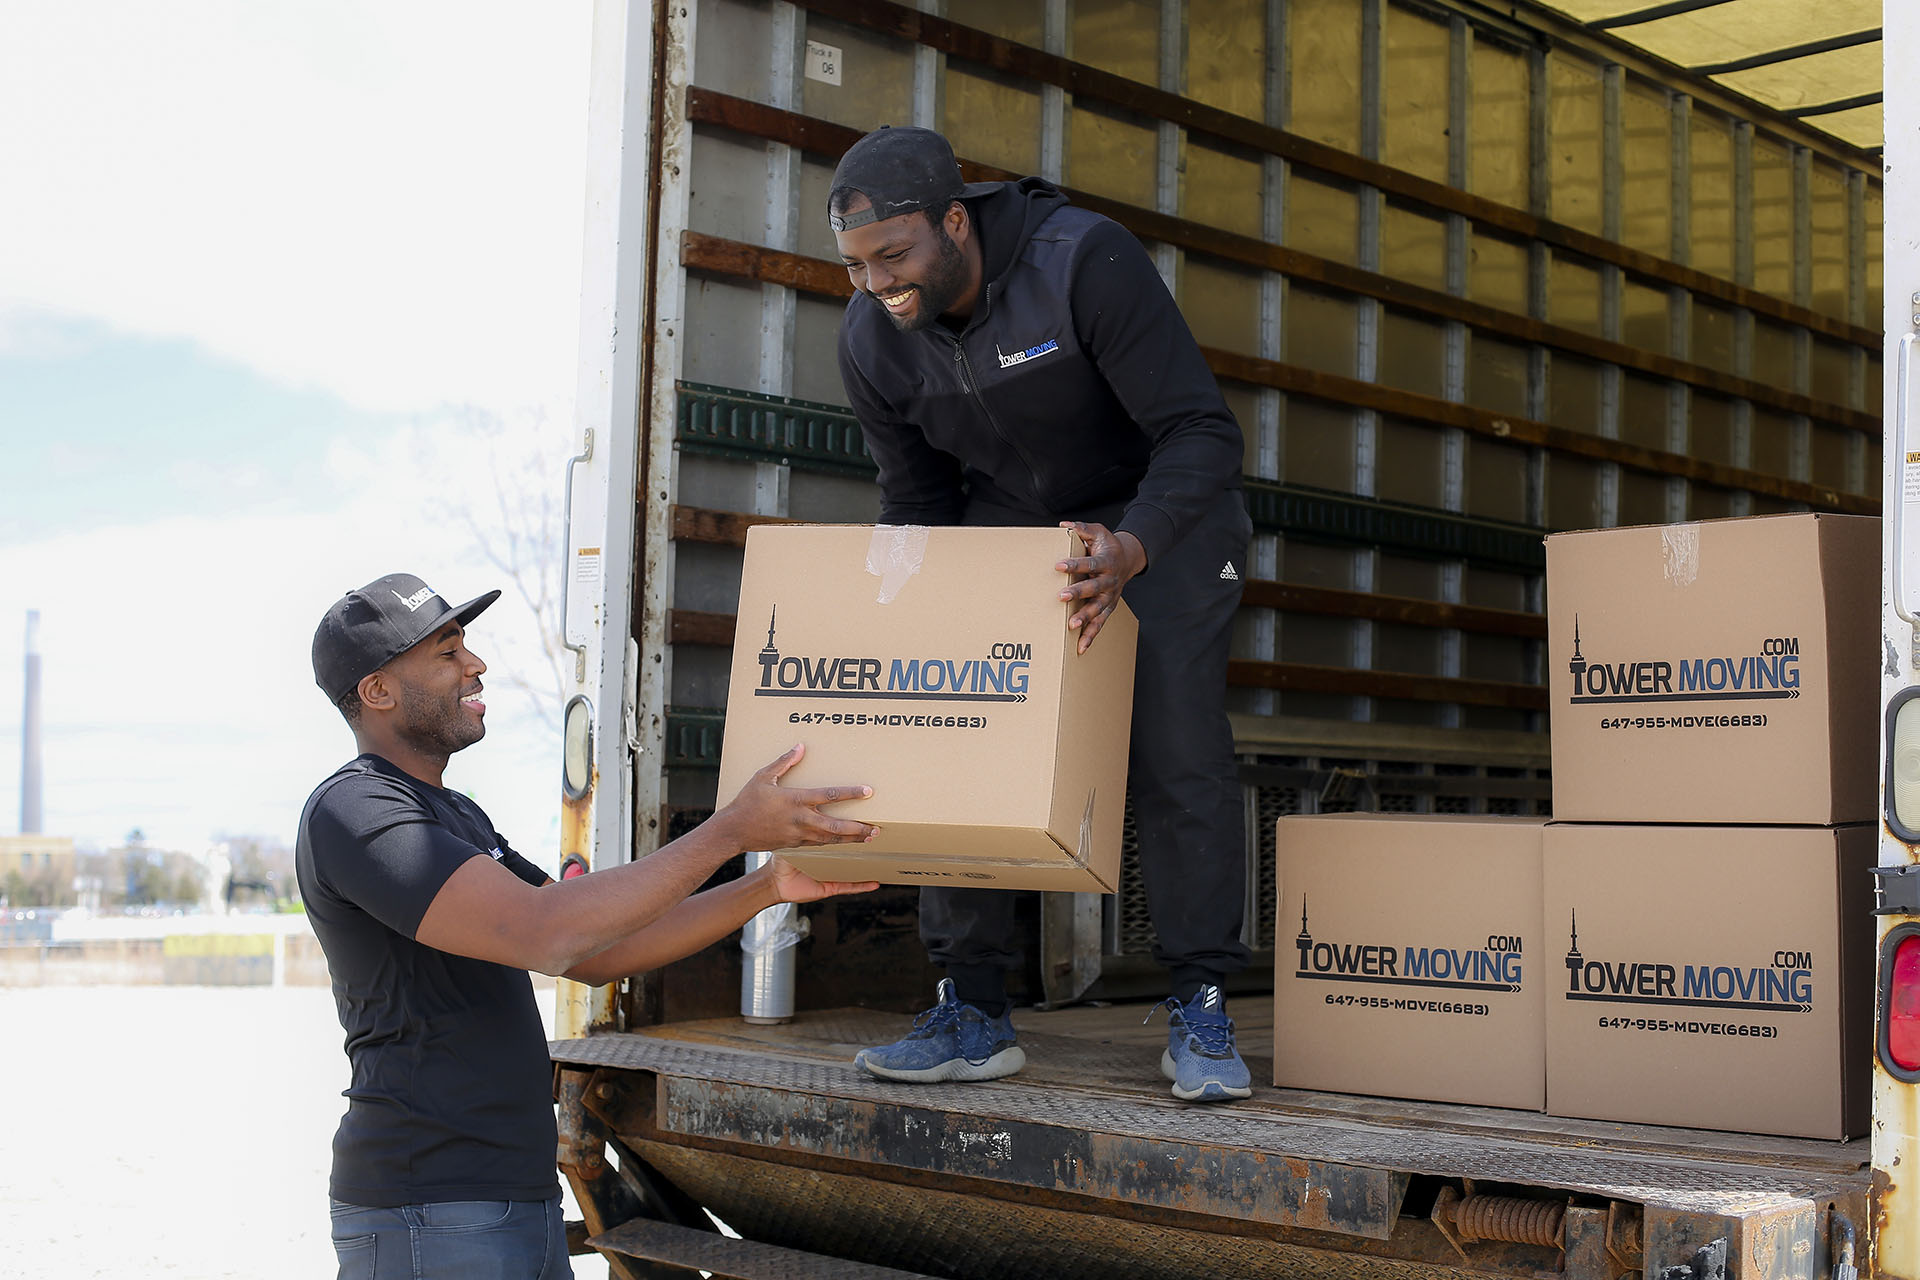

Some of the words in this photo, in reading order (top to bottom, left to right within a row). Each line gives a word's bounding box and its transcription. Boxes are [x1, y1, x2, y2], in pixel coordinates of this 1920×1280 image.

[822, 62, 834, 75] 06
[998, 350, 1026, 366] TOWER
[1025, 339, 1057, 357] MOVING
[1220, 572, 1239, 580] adidas
[986, 643, 1031, 660] .COM
[1759, 637, 1799, 656] .COM
[758, 645, 882, 690] TOWER
[887, 659, 1030, 694] MOVING
[1569, 653, 1673, 695] TOWER
[1678, 656, 1800, 692] MOVING
[788, 712, 987, 729] 647-955-MOVE(6683)
[1600, 714, 1768, 730] 647-955-MOVE(6683)
[1483, 935, 1522, 953] .COM
[1296, 933, 1398, 977] TOWER
[1403, 946, 1522, 984] MOVING
[1770, 951, 1812, 970] .COM
[1565, 951, 1677, 997] TOWER
[1682, 964, 1813, 1004] MOVING
[1324, 994, 1490, 1017] 647-955-MOVE(6683)
[1598, 1016, 1778, 1039] 647-955-MOVE(6683)
